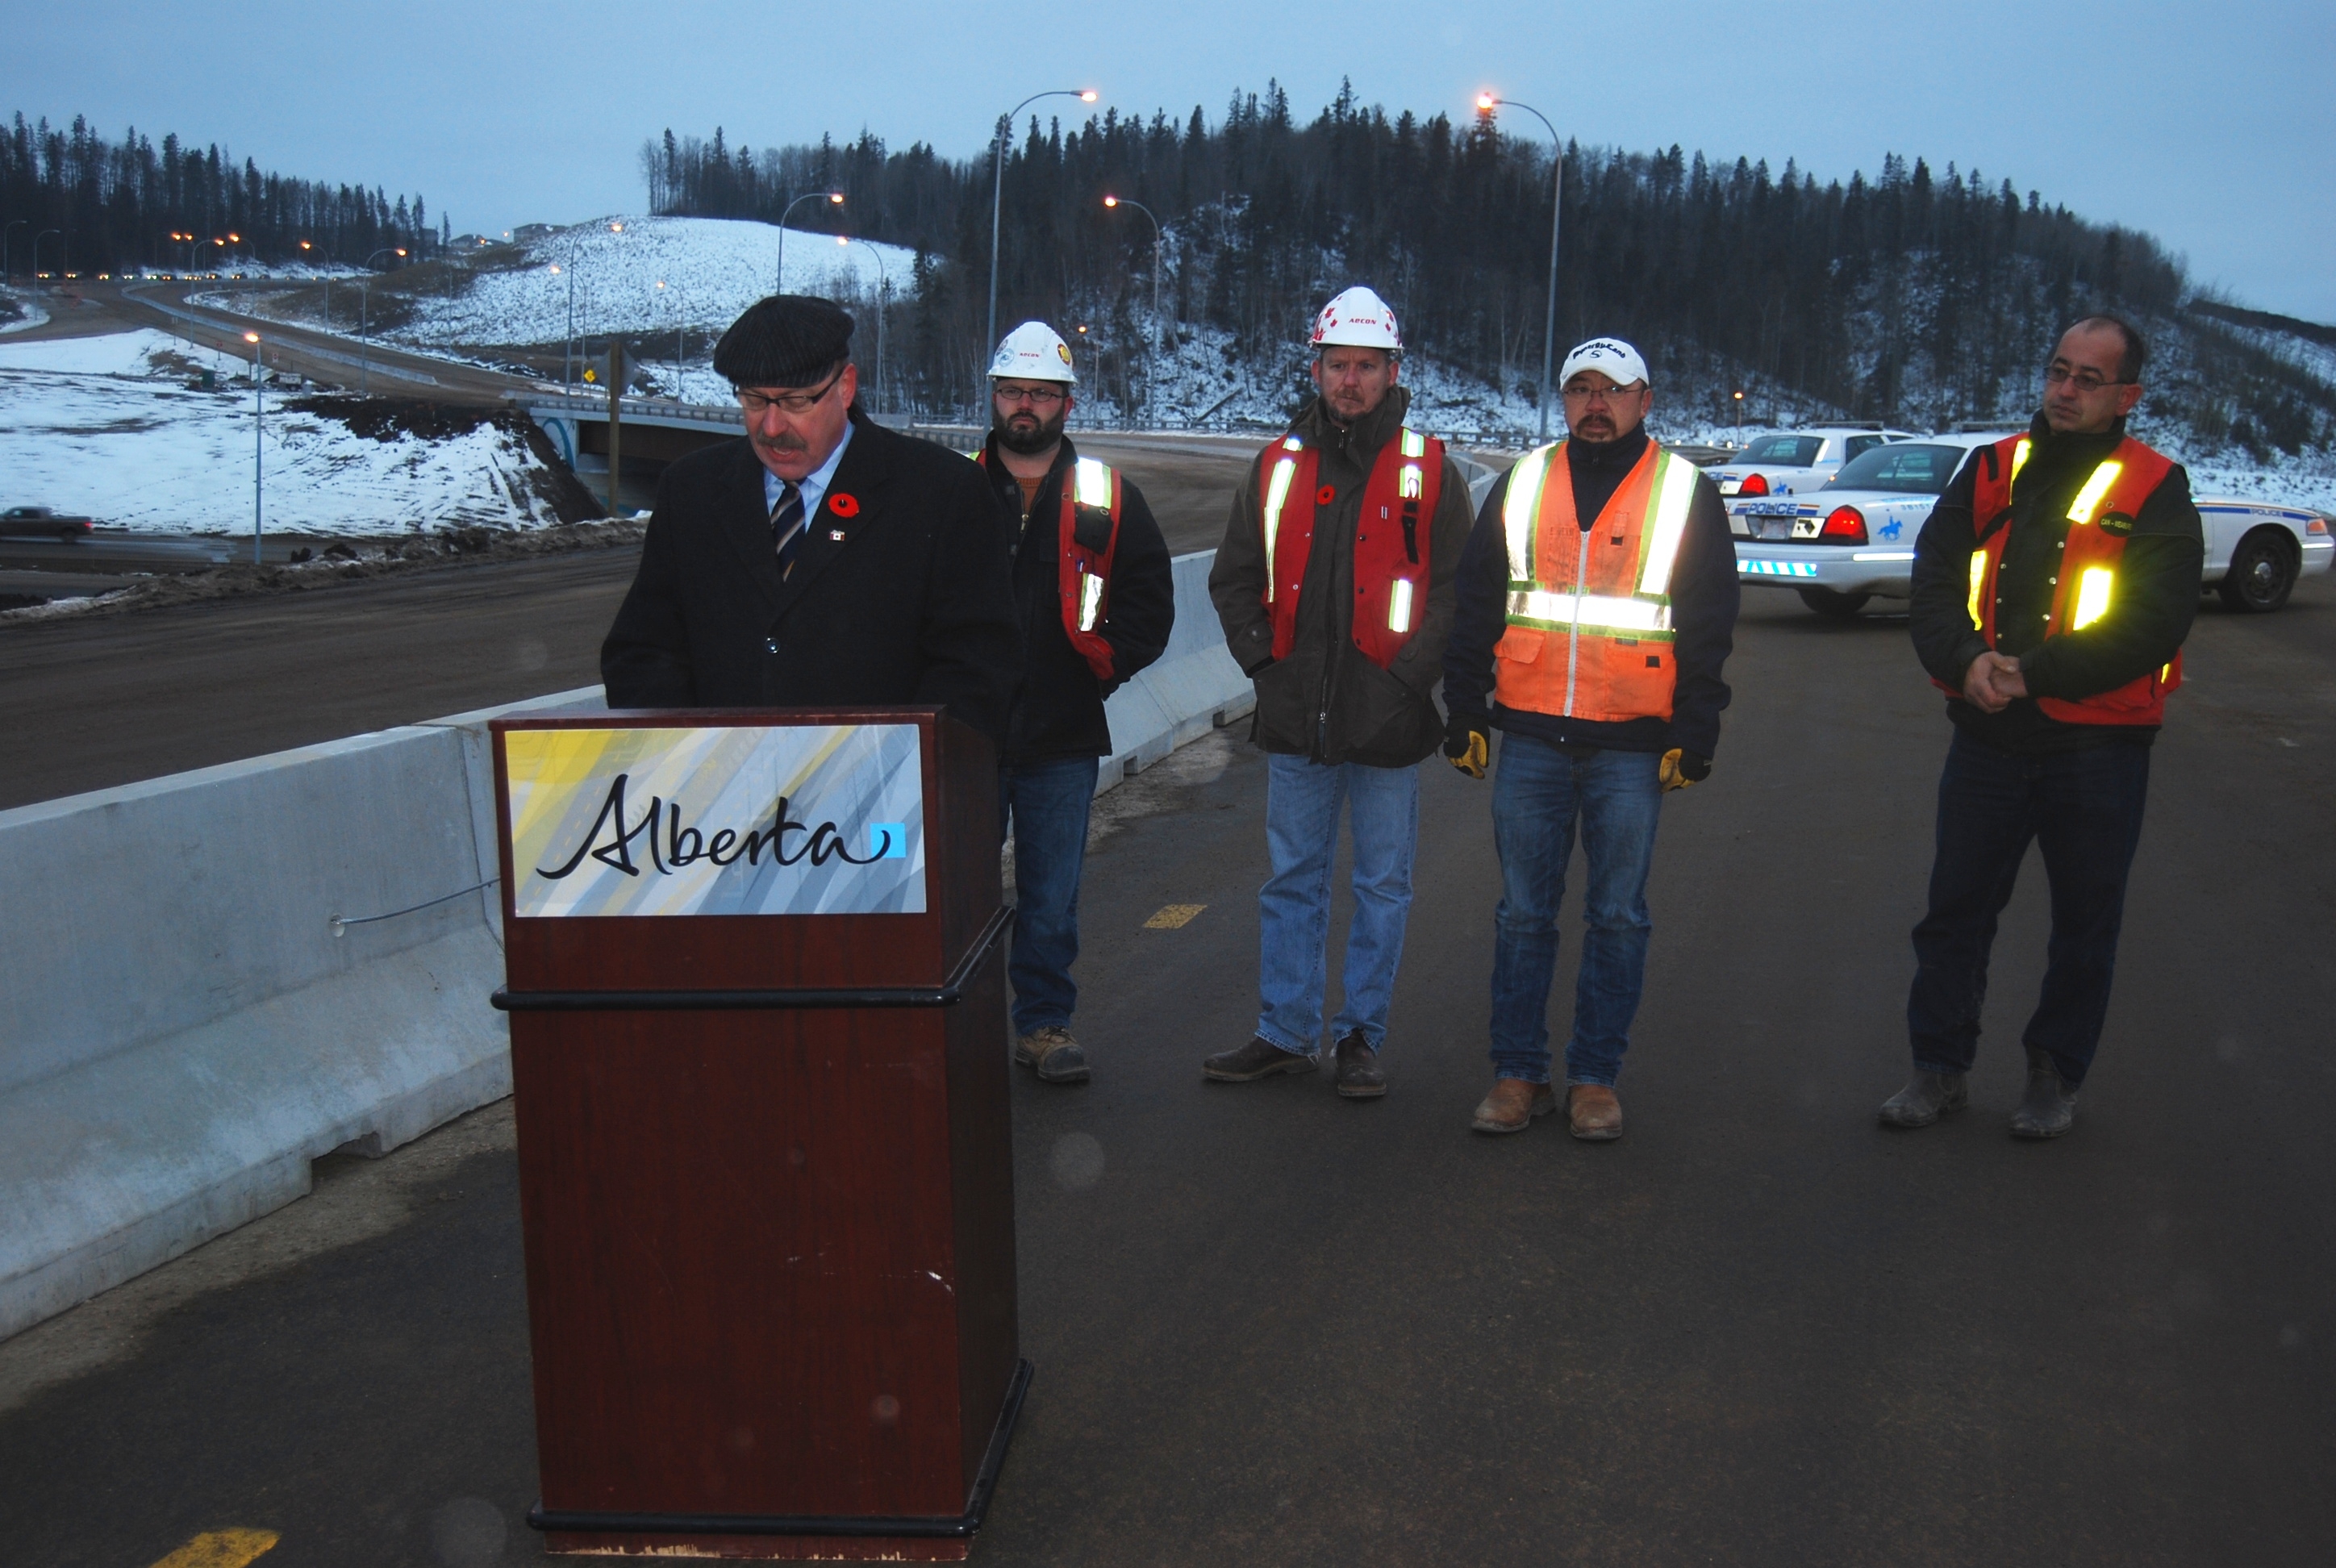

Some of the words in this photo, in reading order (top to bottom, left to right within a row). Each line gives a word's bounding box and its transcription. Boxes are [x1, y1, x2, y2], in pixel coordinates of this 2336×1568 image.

[1749, 503, 1797, 515] POLICE
[2251, 508, 2282, 517] POLICE
[536, 774, 891, 879] Alberta
